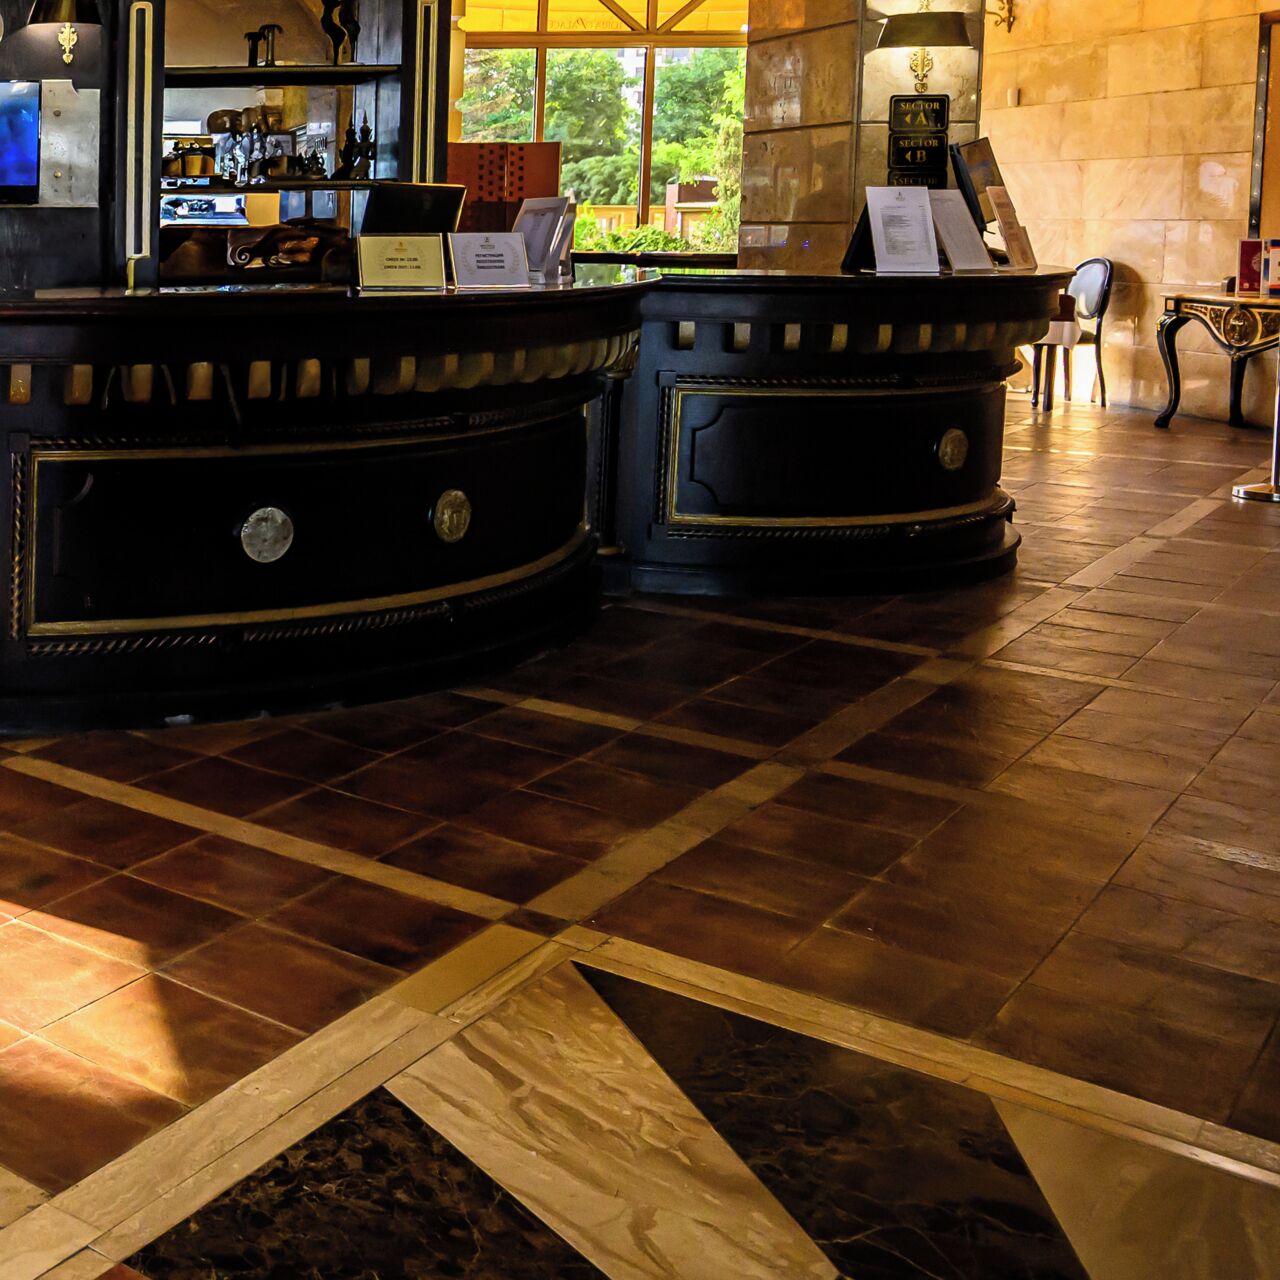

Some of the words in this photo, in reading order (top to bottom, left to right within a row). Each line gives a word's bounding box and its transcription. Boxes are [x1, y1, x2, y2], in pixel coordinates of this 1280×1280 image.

[900, 102, 940, 110] SECTOR
[915, 111, 928, 125] A
[899, 139, 939, 147] SECTOR
[915, 150, 927, 162] B
